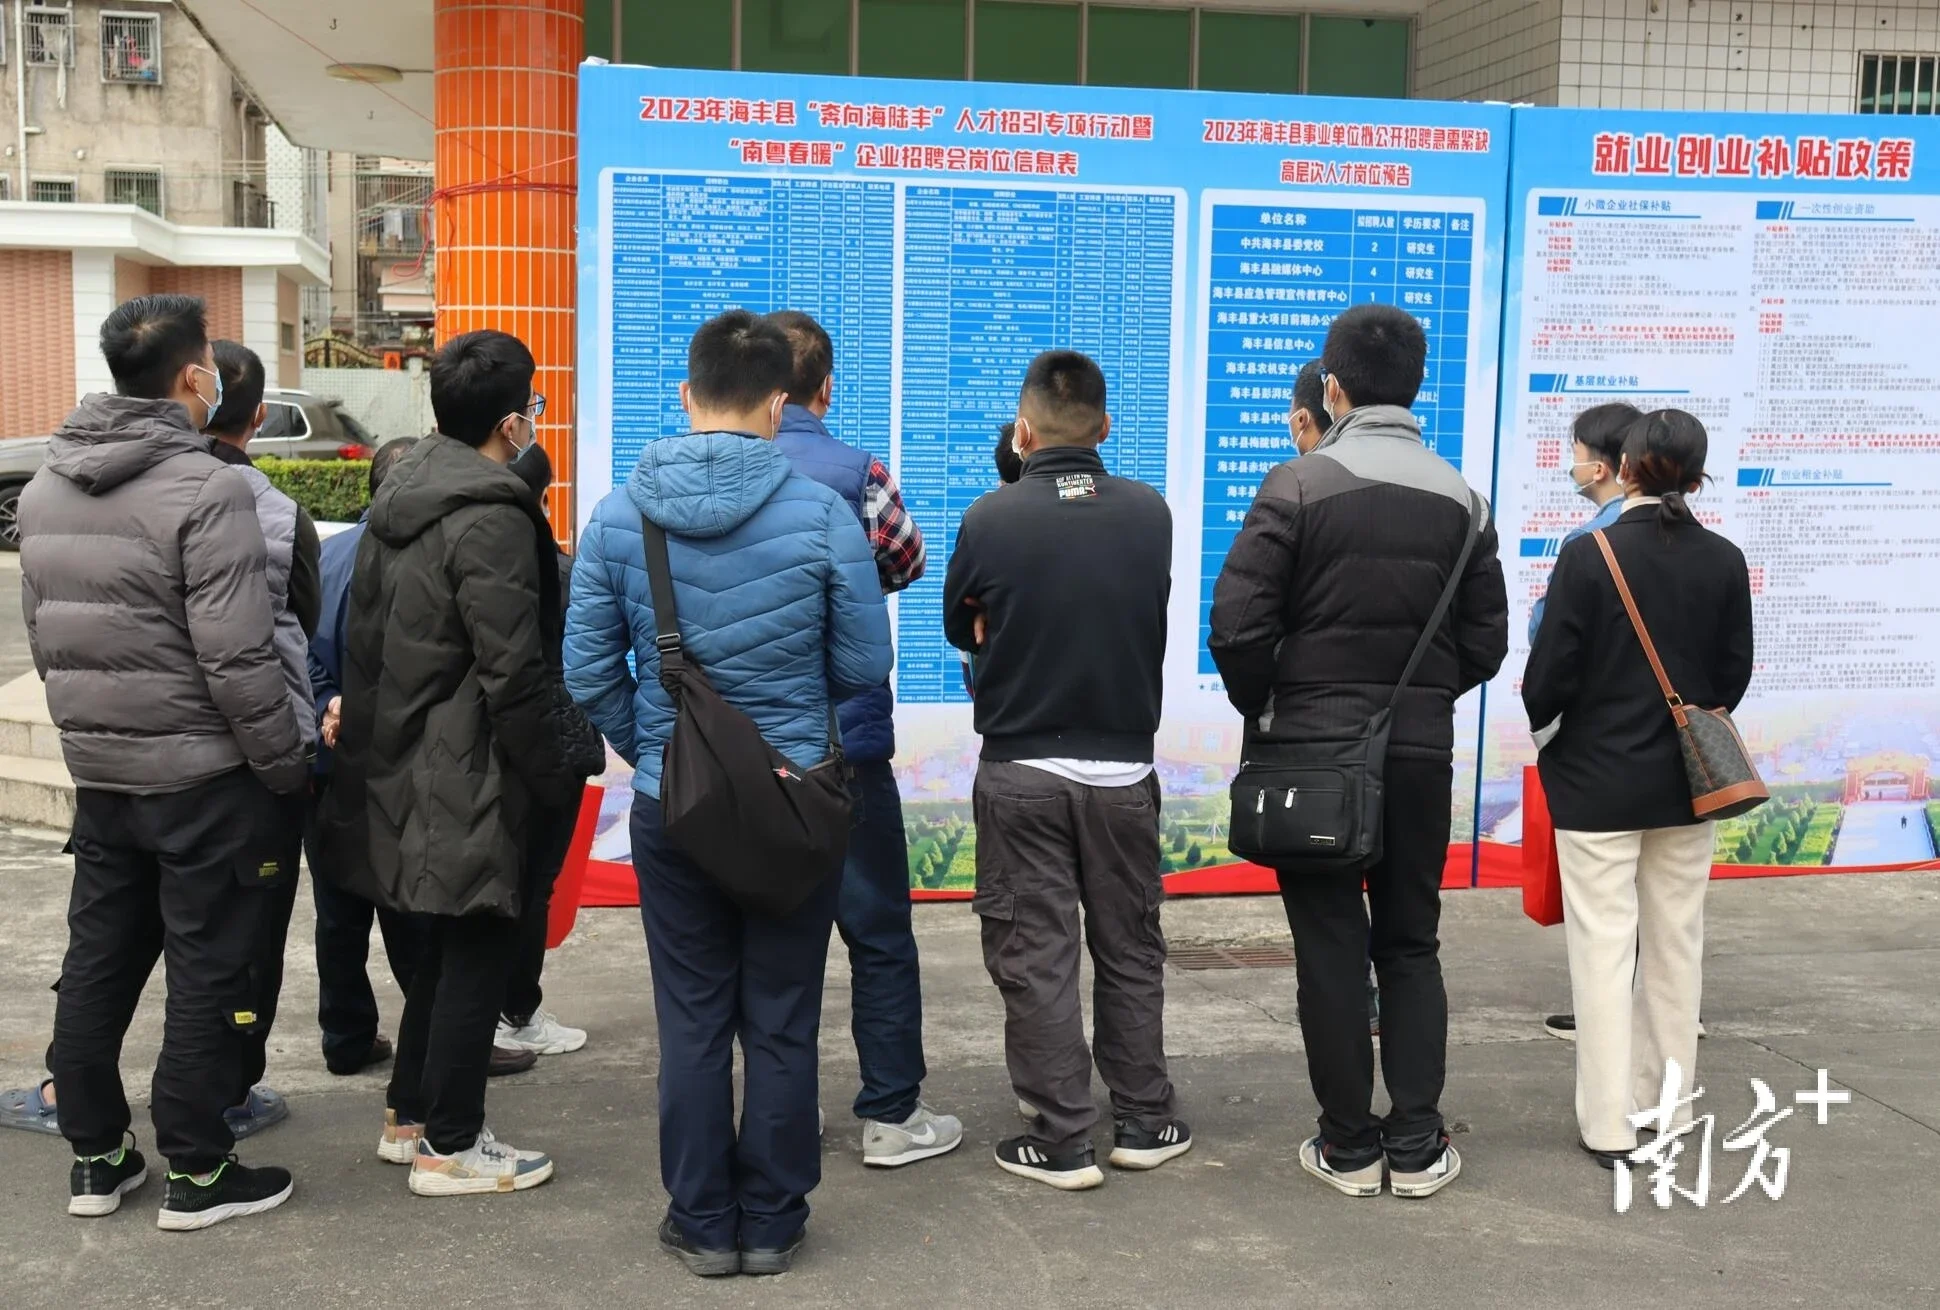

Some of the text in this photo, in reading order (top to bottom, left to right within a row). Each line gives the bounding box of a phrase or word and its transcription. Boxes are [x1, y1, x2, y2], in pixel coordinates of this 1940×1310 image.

[1204, 120, 1489, 152] 2023年海丰县事业单位拟公开招聘急需紧缺
[730, 140, 1080, 175] “南粤春暖”企业招聘会岗位信息表
[1594, 133, 1912, 178] 就业创业补贴政策
[1281, 160, 1410, 186] 高层次人才岗位预告
[1584, 198, 1672, 212] 小微企业社保补贴
[1801, 202, 1876, 215] 一次性创业资助
[1260, 212, 1307, 226] 单位名称
[1403, 217, 1441, 230] 学历要求
[1451, 218, 1470, 231] 备注
[1240, 236, 1436, 255] 中共海丰县委党校 2 研究生
[1239, 261, 1435, 280] 海丰县融媒体中心 4 研究生
[1212, 286, 1348, 302] 海丰县应急管理宣传教育中心
[1404, 291, 1433, 305] 研究生
[1242, 337, 1315, 351] 海丰县信息中心
[1574, 374, 1640, 388] 基层就业补贴
[1218, 436, 1294, 449] 海丰县梅陇镇中
[1781, 469, 1843, 481] 创业租金补贴
